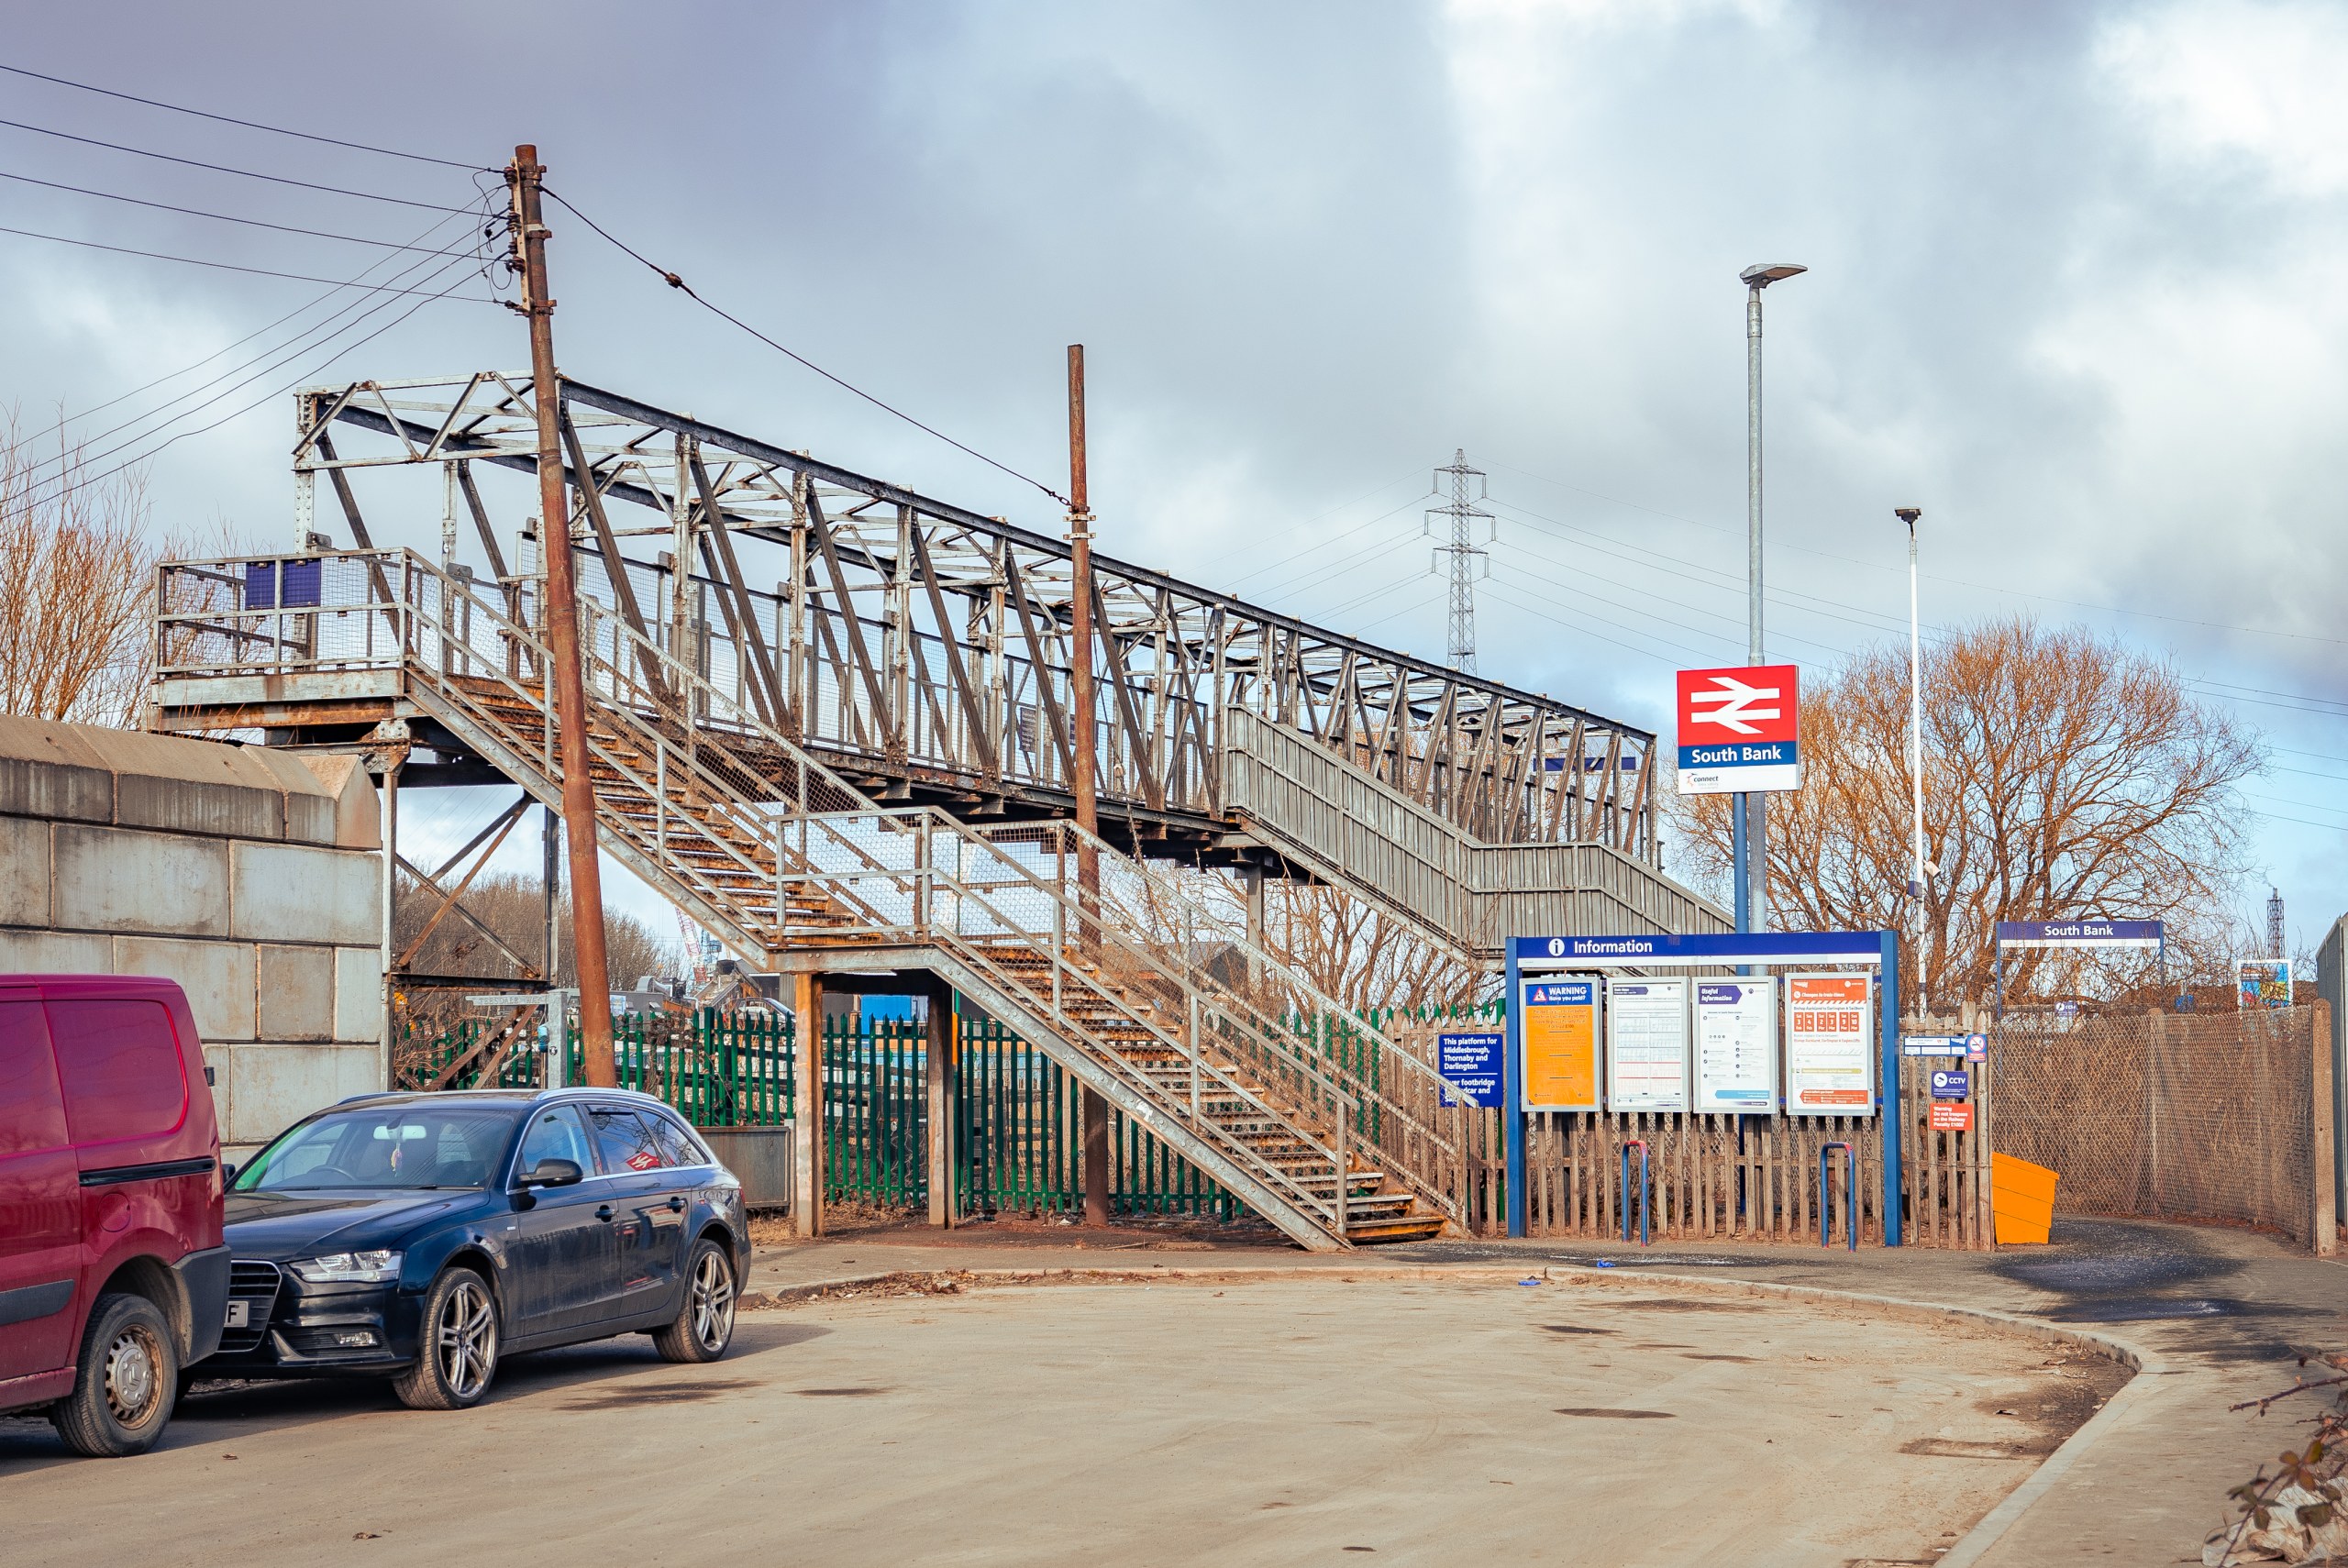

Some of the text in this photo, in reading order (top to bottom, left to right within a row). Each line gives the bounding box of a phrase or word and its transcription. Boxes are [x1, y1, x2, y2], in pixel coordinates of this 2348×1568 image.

[1691, 745, 1782, 763] South Bank
[2044, 925, 2113, 936] South Bank
[1574, 940, 1652, 954] Information
[1548, 987, 1587, 995] WARNING
[479, 997, 518, 1005] TEESDALE
[1458, 1037, 1486, 1045] platform
[1444, 1046, 1490, 1055] Middlesbrough,
[1444, 1055, 1475, 1063] Thornaby
[1444, 1063, 1479, 1071] Darlington
[1461, 1078, 1495, 1087] footbridge
